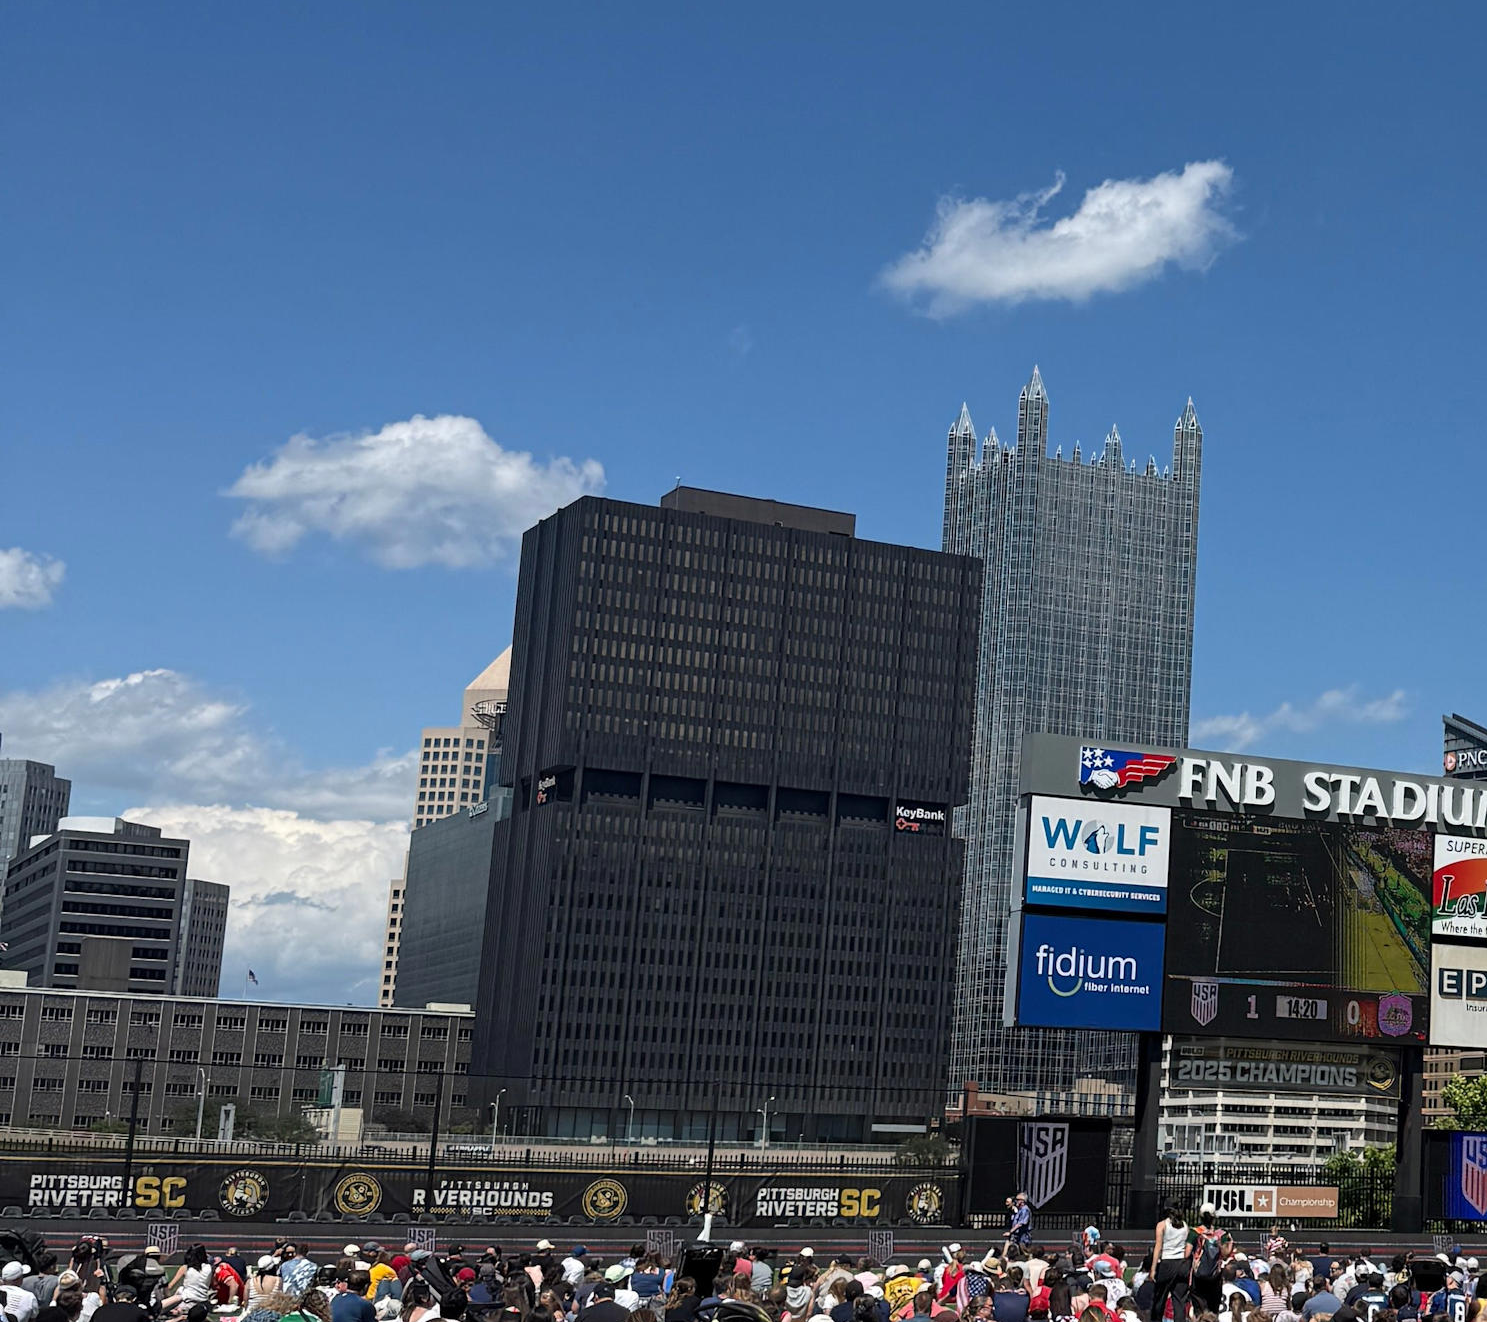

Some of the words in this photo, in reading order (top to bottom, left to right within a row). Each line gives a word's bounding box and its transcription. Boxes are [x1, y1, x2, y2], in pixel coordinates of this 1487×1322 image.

[1459, 750, 1487, 769] PNC
[1178, 757, 1275, 805] FNB
[896, 806, 945, 820] KeyBank
[1050, 858, 1147, 874] CONSULTING
[1032, 885, 1063, 895] MANAGED
[1064, 887, 1071, 895] IT
[1078, 888, 1129, 900] CYBERSECURITY
[1131, 892, 1161, 901] SERVICES
[1438, 875, 1479, 919] Las
[1441, 921, 1467, 934] Where
[1470, 922, 1482, 934] the
[1035, 944, 1137, 980] fidium
[1084, 981, 1108, 992] fiber
[1194, 984, 1217, 1001] USA
[1246, 994, 1258, 1019] 1
[1288, 1000, 1317, 1018] 14:20
[1347, 1000, 1360, 1025] 0
[1226, 1047, 1289, 1061] PITTSBURGH
[1290, 1051, 1359, 1064] RIVERHOUNDS
[1178, 1060, 1232, 1081] 2025
[1236, 1061, 1357, 1087] CHAMPIONS
[1020, 1127, 1065, 1158] USA
[135, 1176, 187, 1208] SC
[441, 1180, 529, 1190] PITTSBURGH
[412, 1189, 553, 1207] RVERHOUNDS
[757, 1188, 839, 1200] PITTSBURGH
[840, 1188, 882, 1217] SC
[1279, 1196, 1335, 1207] Championship
[472, 1207, 493, 1216] SC
[756, 1200, 838, 1217] RIVETERS
